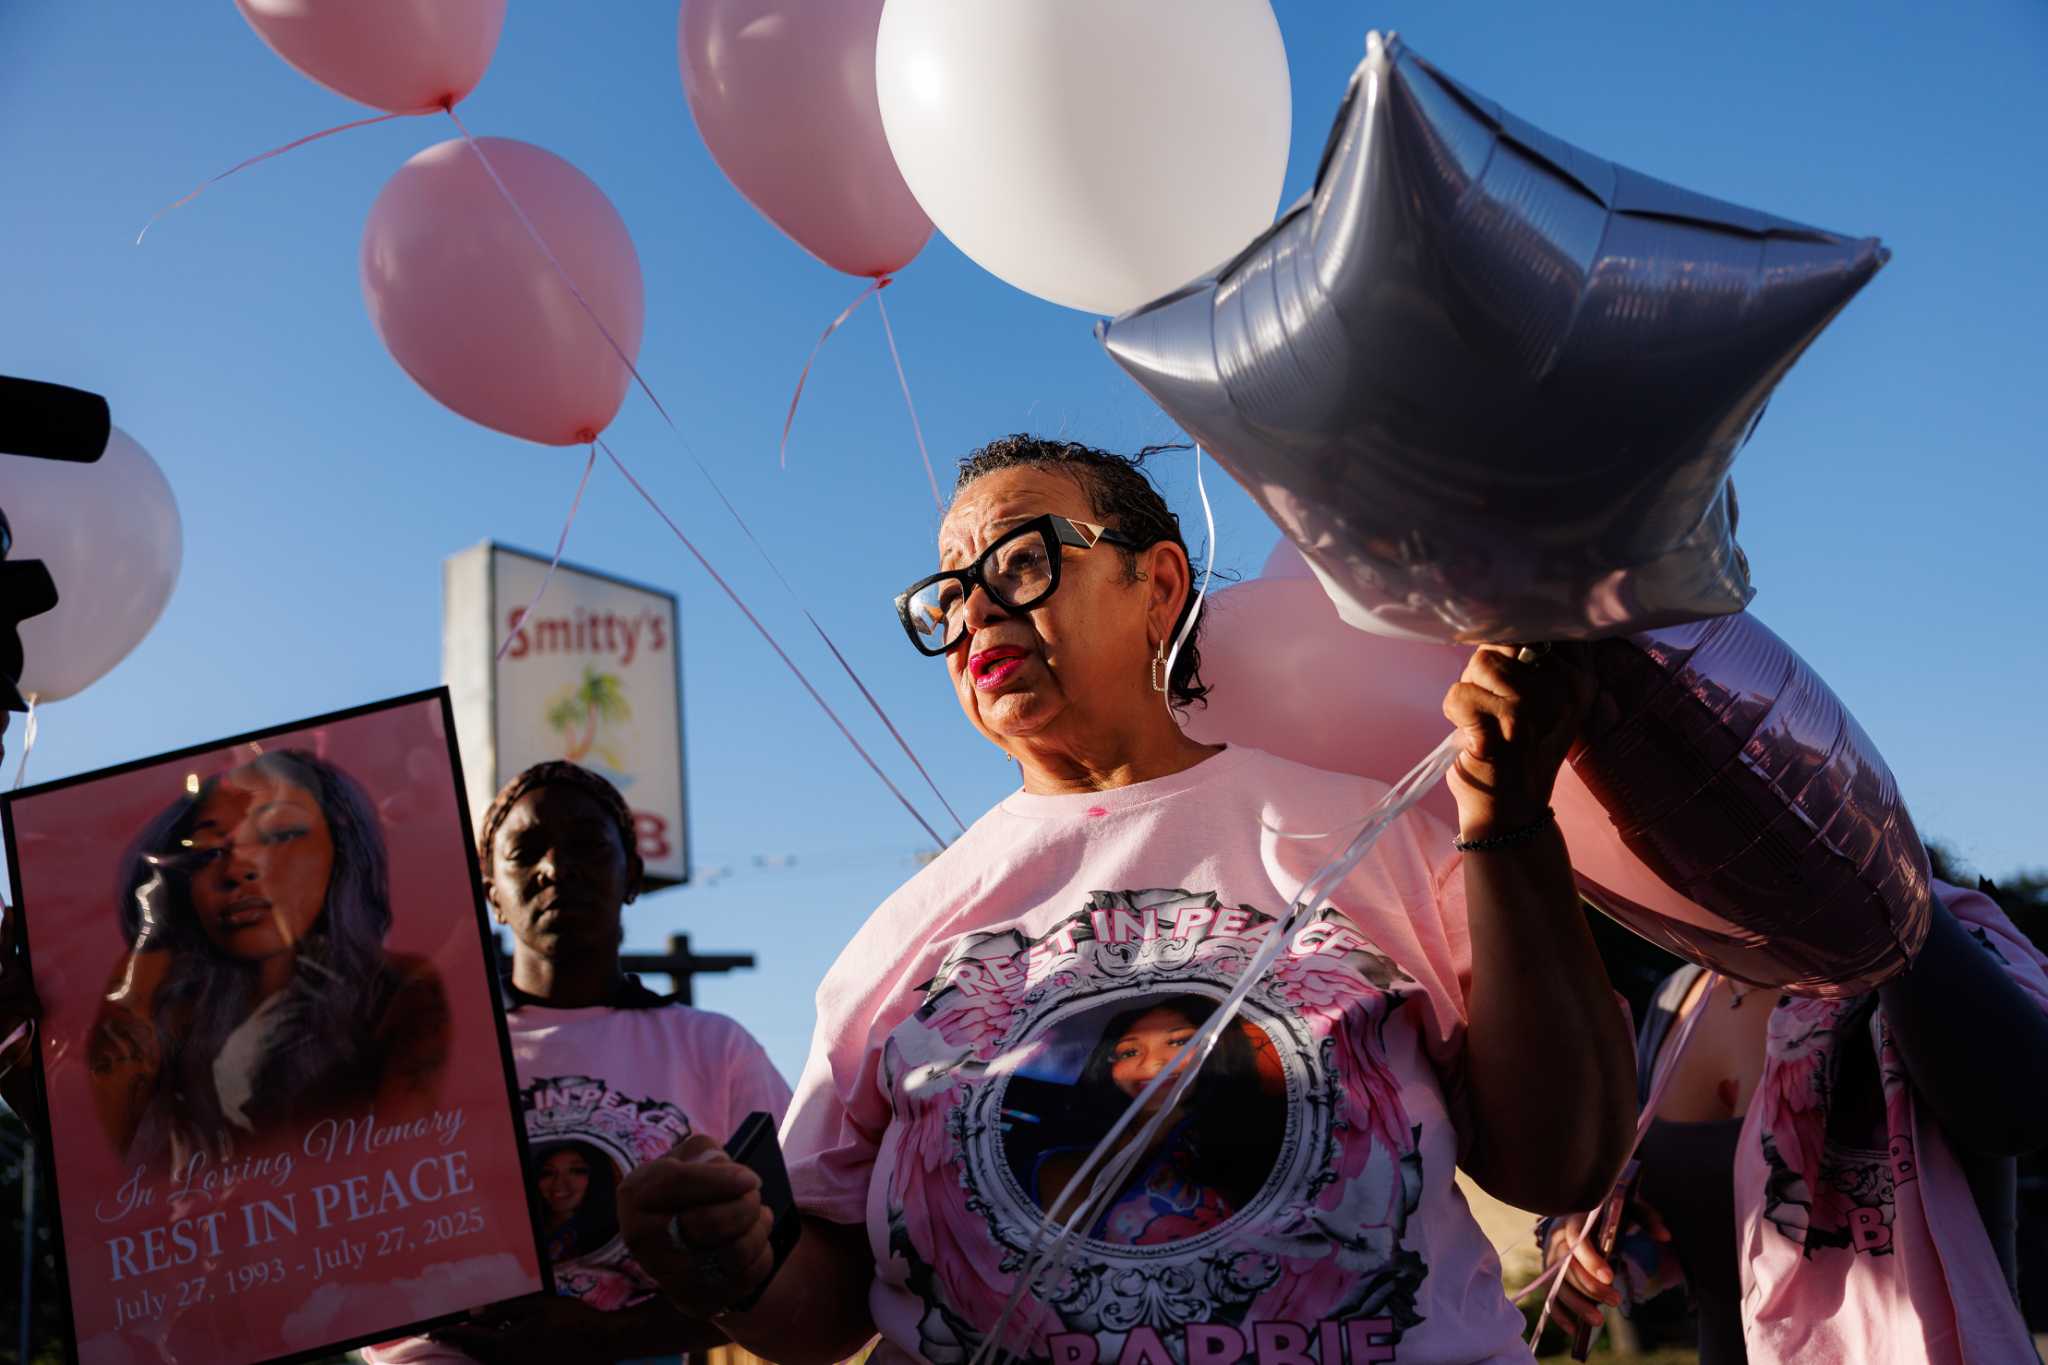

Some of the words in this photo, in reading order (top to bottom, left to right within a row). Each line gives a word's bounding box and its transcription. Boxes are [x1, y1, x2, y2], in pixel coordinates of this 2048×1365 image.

[506, 605, 666, 665] Smitty's
[954, 920, 1079, 998] REST
[1090, 907, 1160, 945] IN
[534, 1088, 571, 1111] IN
[579, 1089, 687, 1135] PEACE
[96, 1163, 153, 1222] In
[168, 1151, 295, 1201] Loving
[303, 1107, 464, 1164] Memory
[105, 1211, 226, 1281] REST
[240, 1193, 297, 1248] IN
[311, 1151, 475, 1229] PEACE
[114, 1289, 167, 1330] July
[177, 1277, 216, 1308] 27,
[225, 1258, 286, 1294] 1993
[314, 1238, 367, 1280] July
[376, 1226, 416, 1257] 27,
[424, 1206, 485, 1244] 2025
